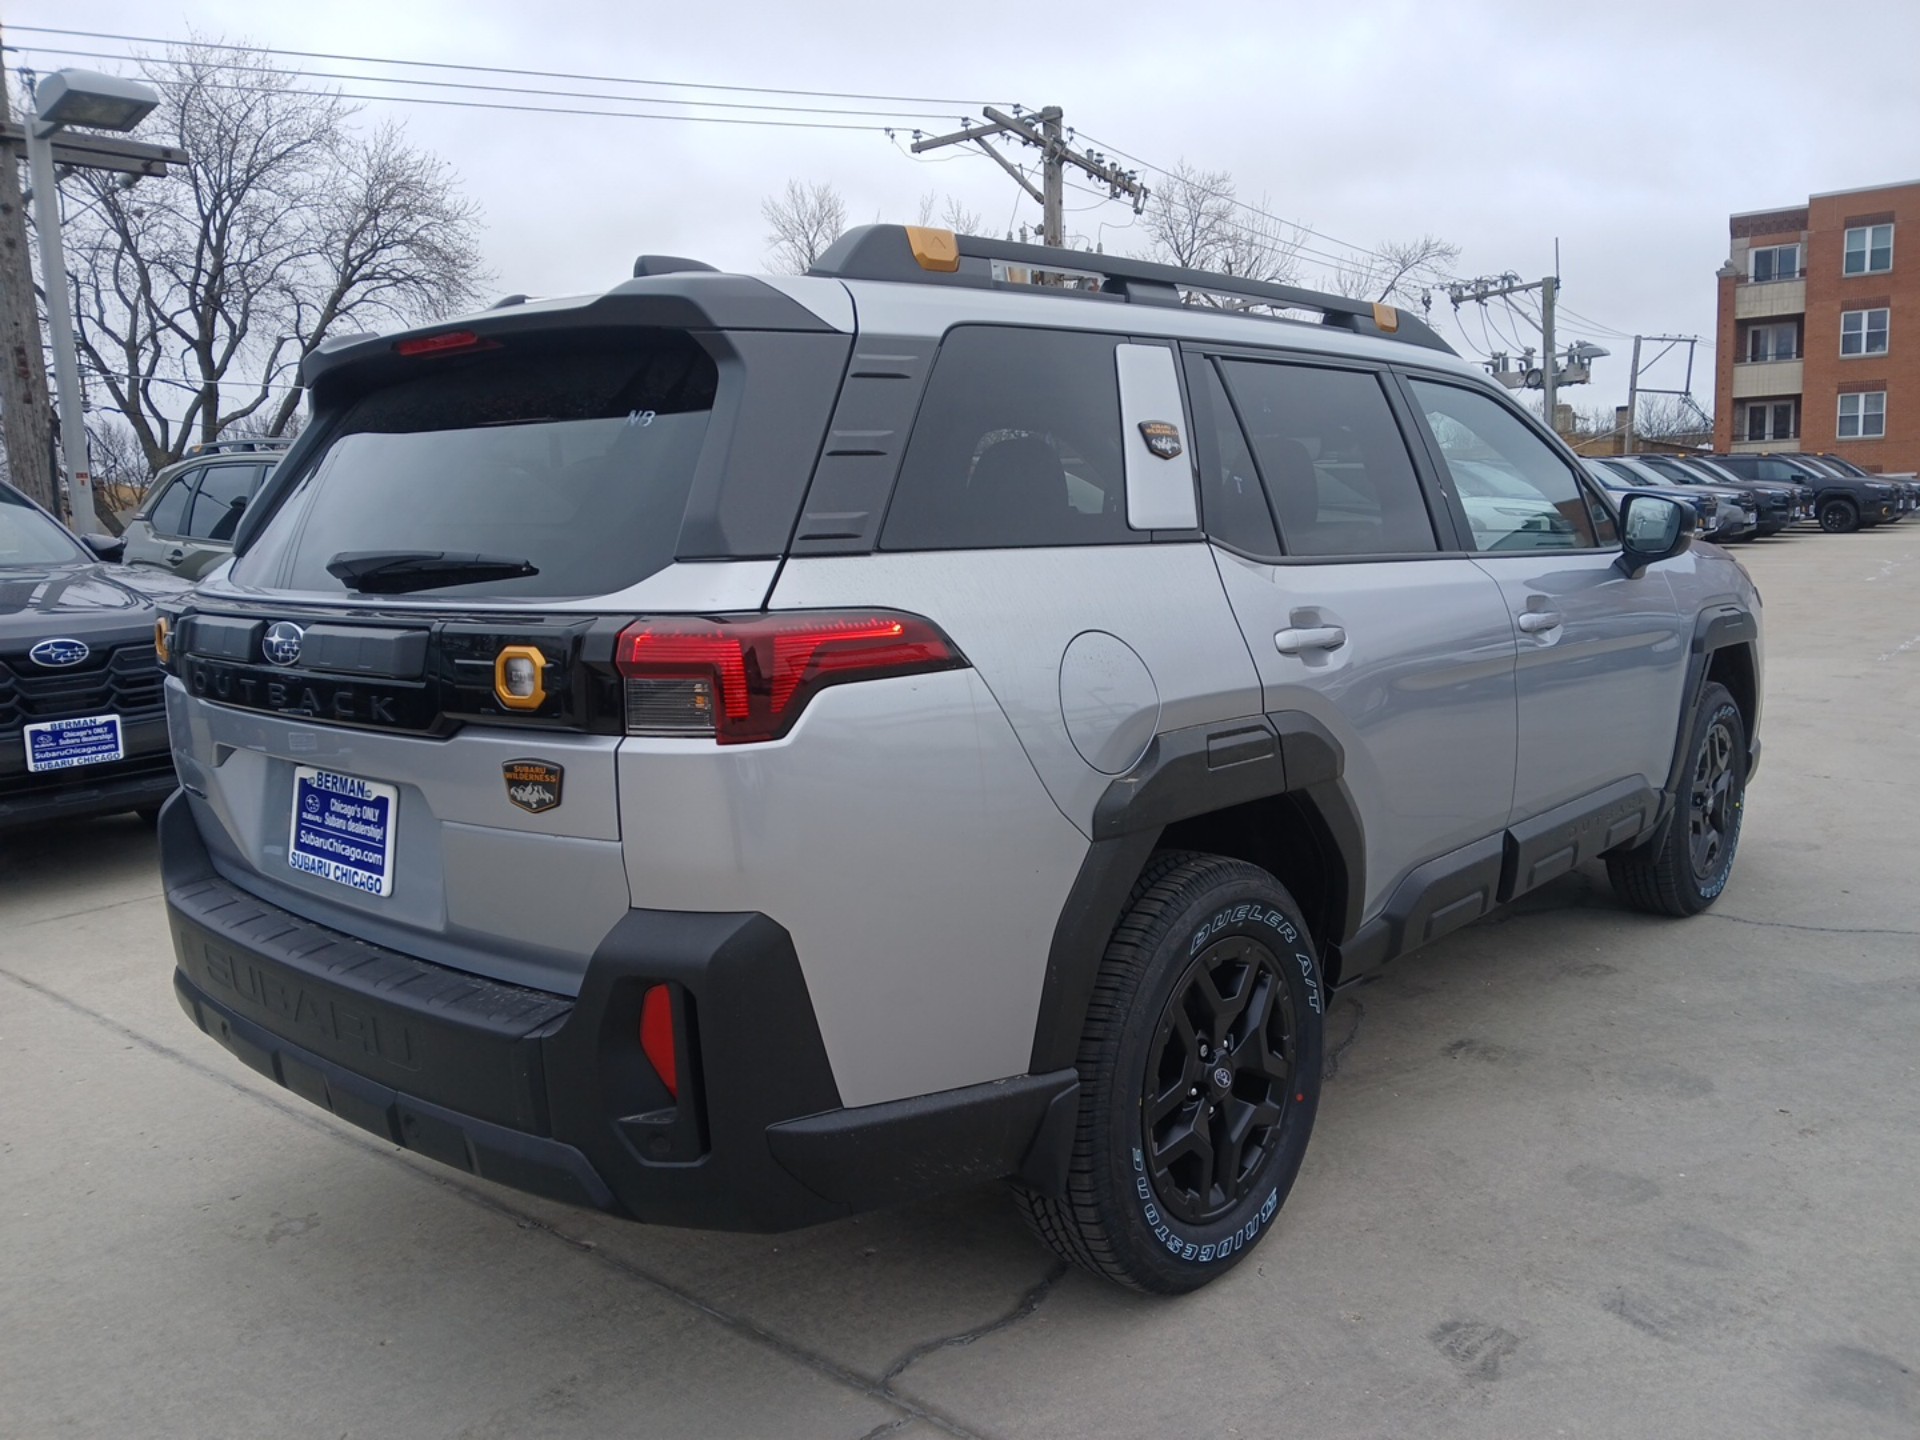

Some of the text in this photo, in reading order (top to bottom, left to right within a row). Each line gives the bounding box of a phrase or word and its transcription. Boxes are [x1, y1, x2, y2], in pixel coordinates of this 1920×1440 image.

[194, 671, 395, 722] OUTBACK
[50, 718, 97, 731] BERMAN
[33, 752, 120, 772] SUBARU CHICAGO
[34, 743, 115, 760] SubaruChicago.com
[316, 772, 366, 799] BERMAN
[505, 771, 557, 783] WILDERNESS
[324, 812, 346, 830] Subaru
[330, 798, 380, 822] Chicago's ONLY
[300, 830, 382, 866] SubaruChicago.com
[290, 851, 382, 894] SUBARU CHICAGO
[1190, 904, 1298, 956] DUELER
[1132, 1147, 1277, 1262] BRIDGESTONE
